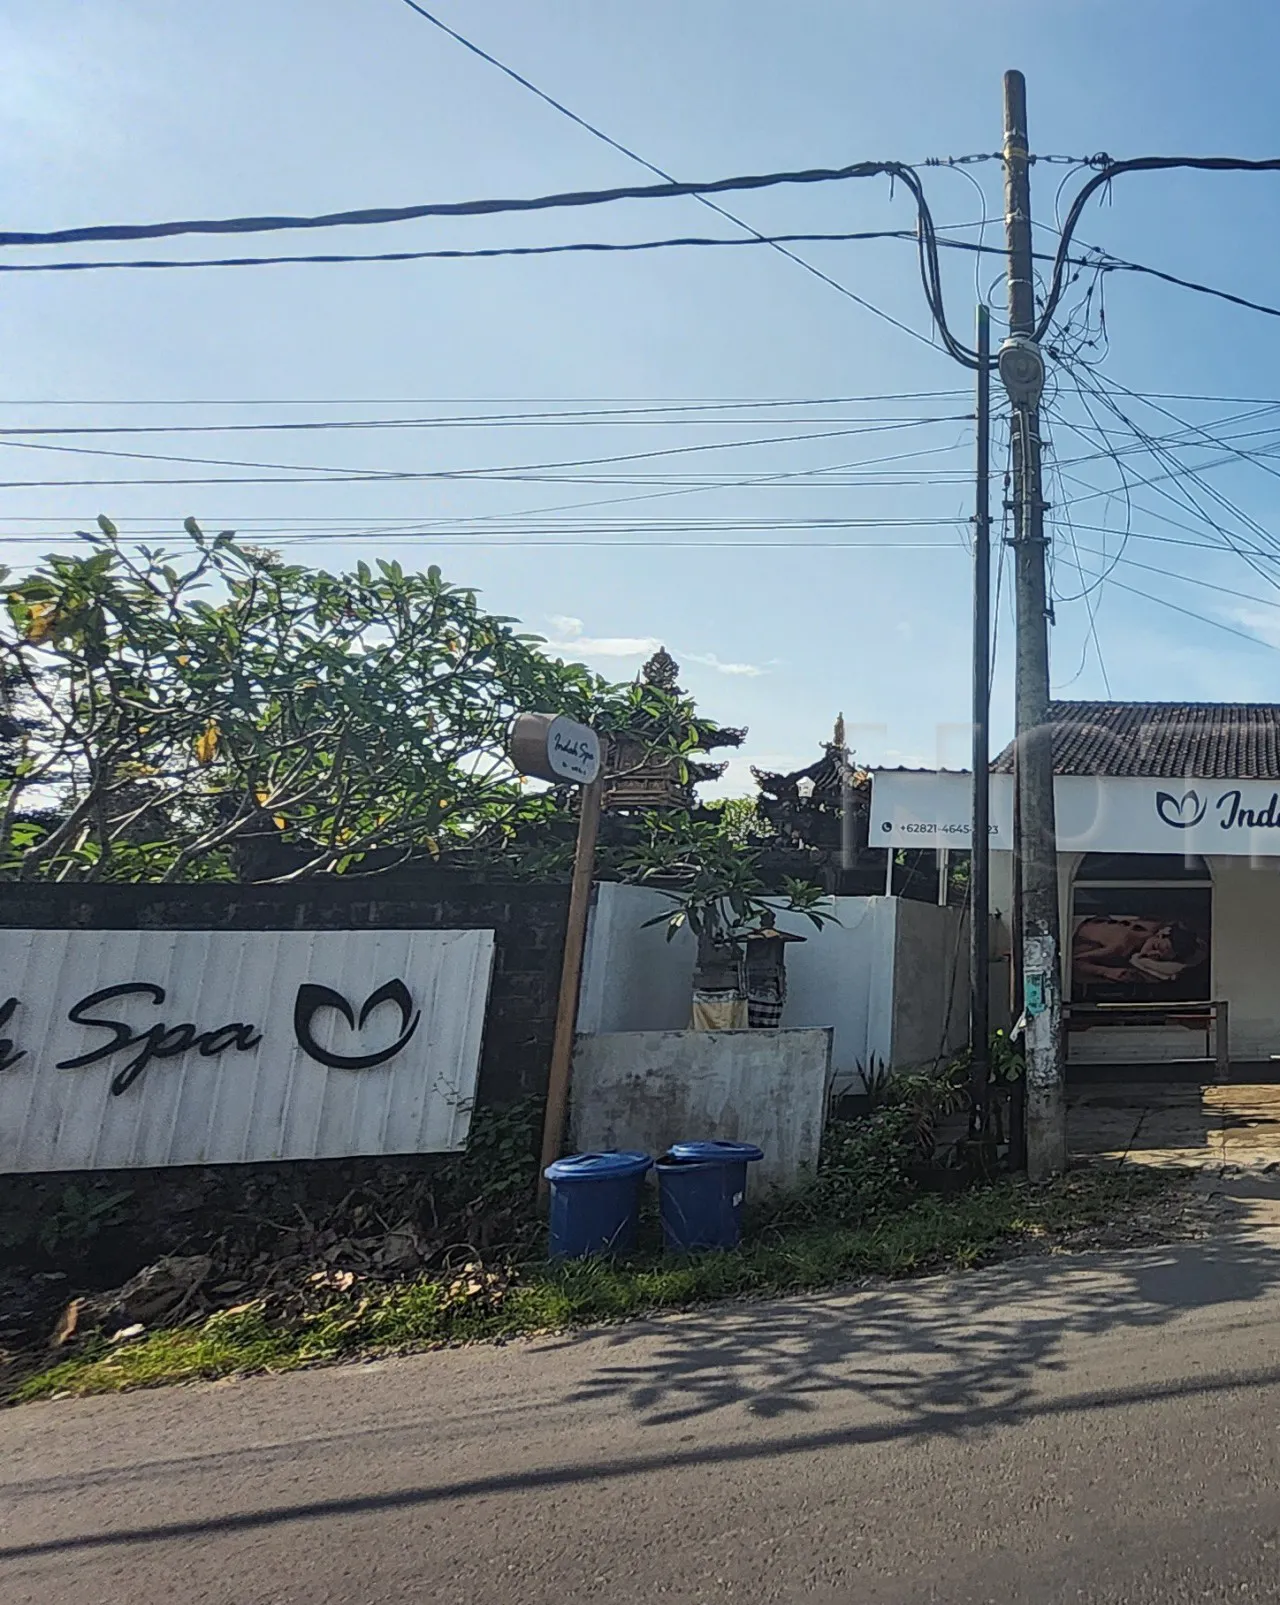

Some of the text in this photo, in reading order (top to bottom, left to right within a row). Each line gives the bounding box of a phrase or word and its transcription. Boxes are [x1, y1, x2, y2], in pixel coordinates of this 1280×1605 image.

[554, 732, 595, 765] Indah Spa
[900, 823, 998, 835] +62821-4645-23
[56, 982, 264, 1097] Spa
